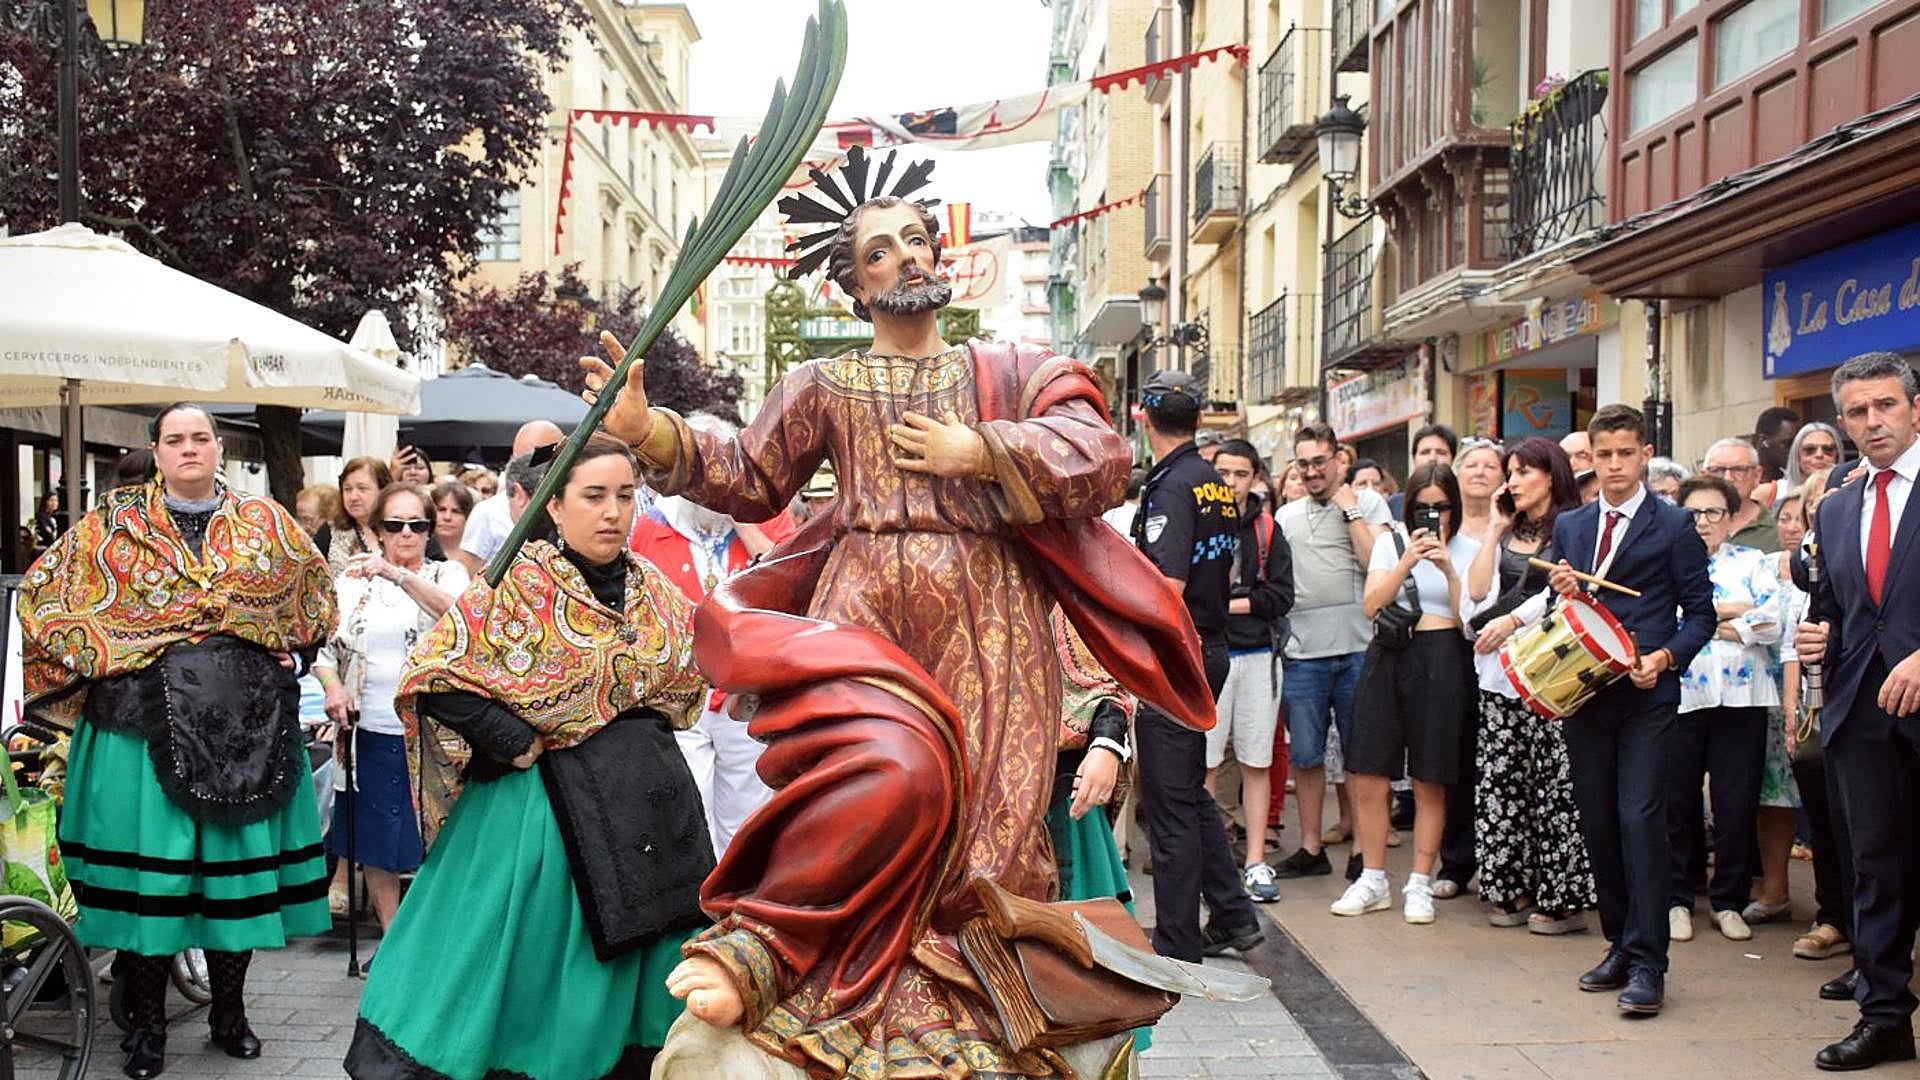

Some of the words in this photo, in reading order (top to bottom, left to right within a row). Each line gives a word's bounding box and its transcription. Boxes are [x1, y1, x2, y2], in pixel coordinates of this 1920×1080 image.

[1797, 292, 1828, 335] La
[1835, 279, 1892, 325] Casa
[820, 321, 839, 337] DE
[841, 321, 875, 337] JUN
[5, 351, 89, 364] CERVECEROS
[94, 353, 202, 373] INDEPENDIENTES
